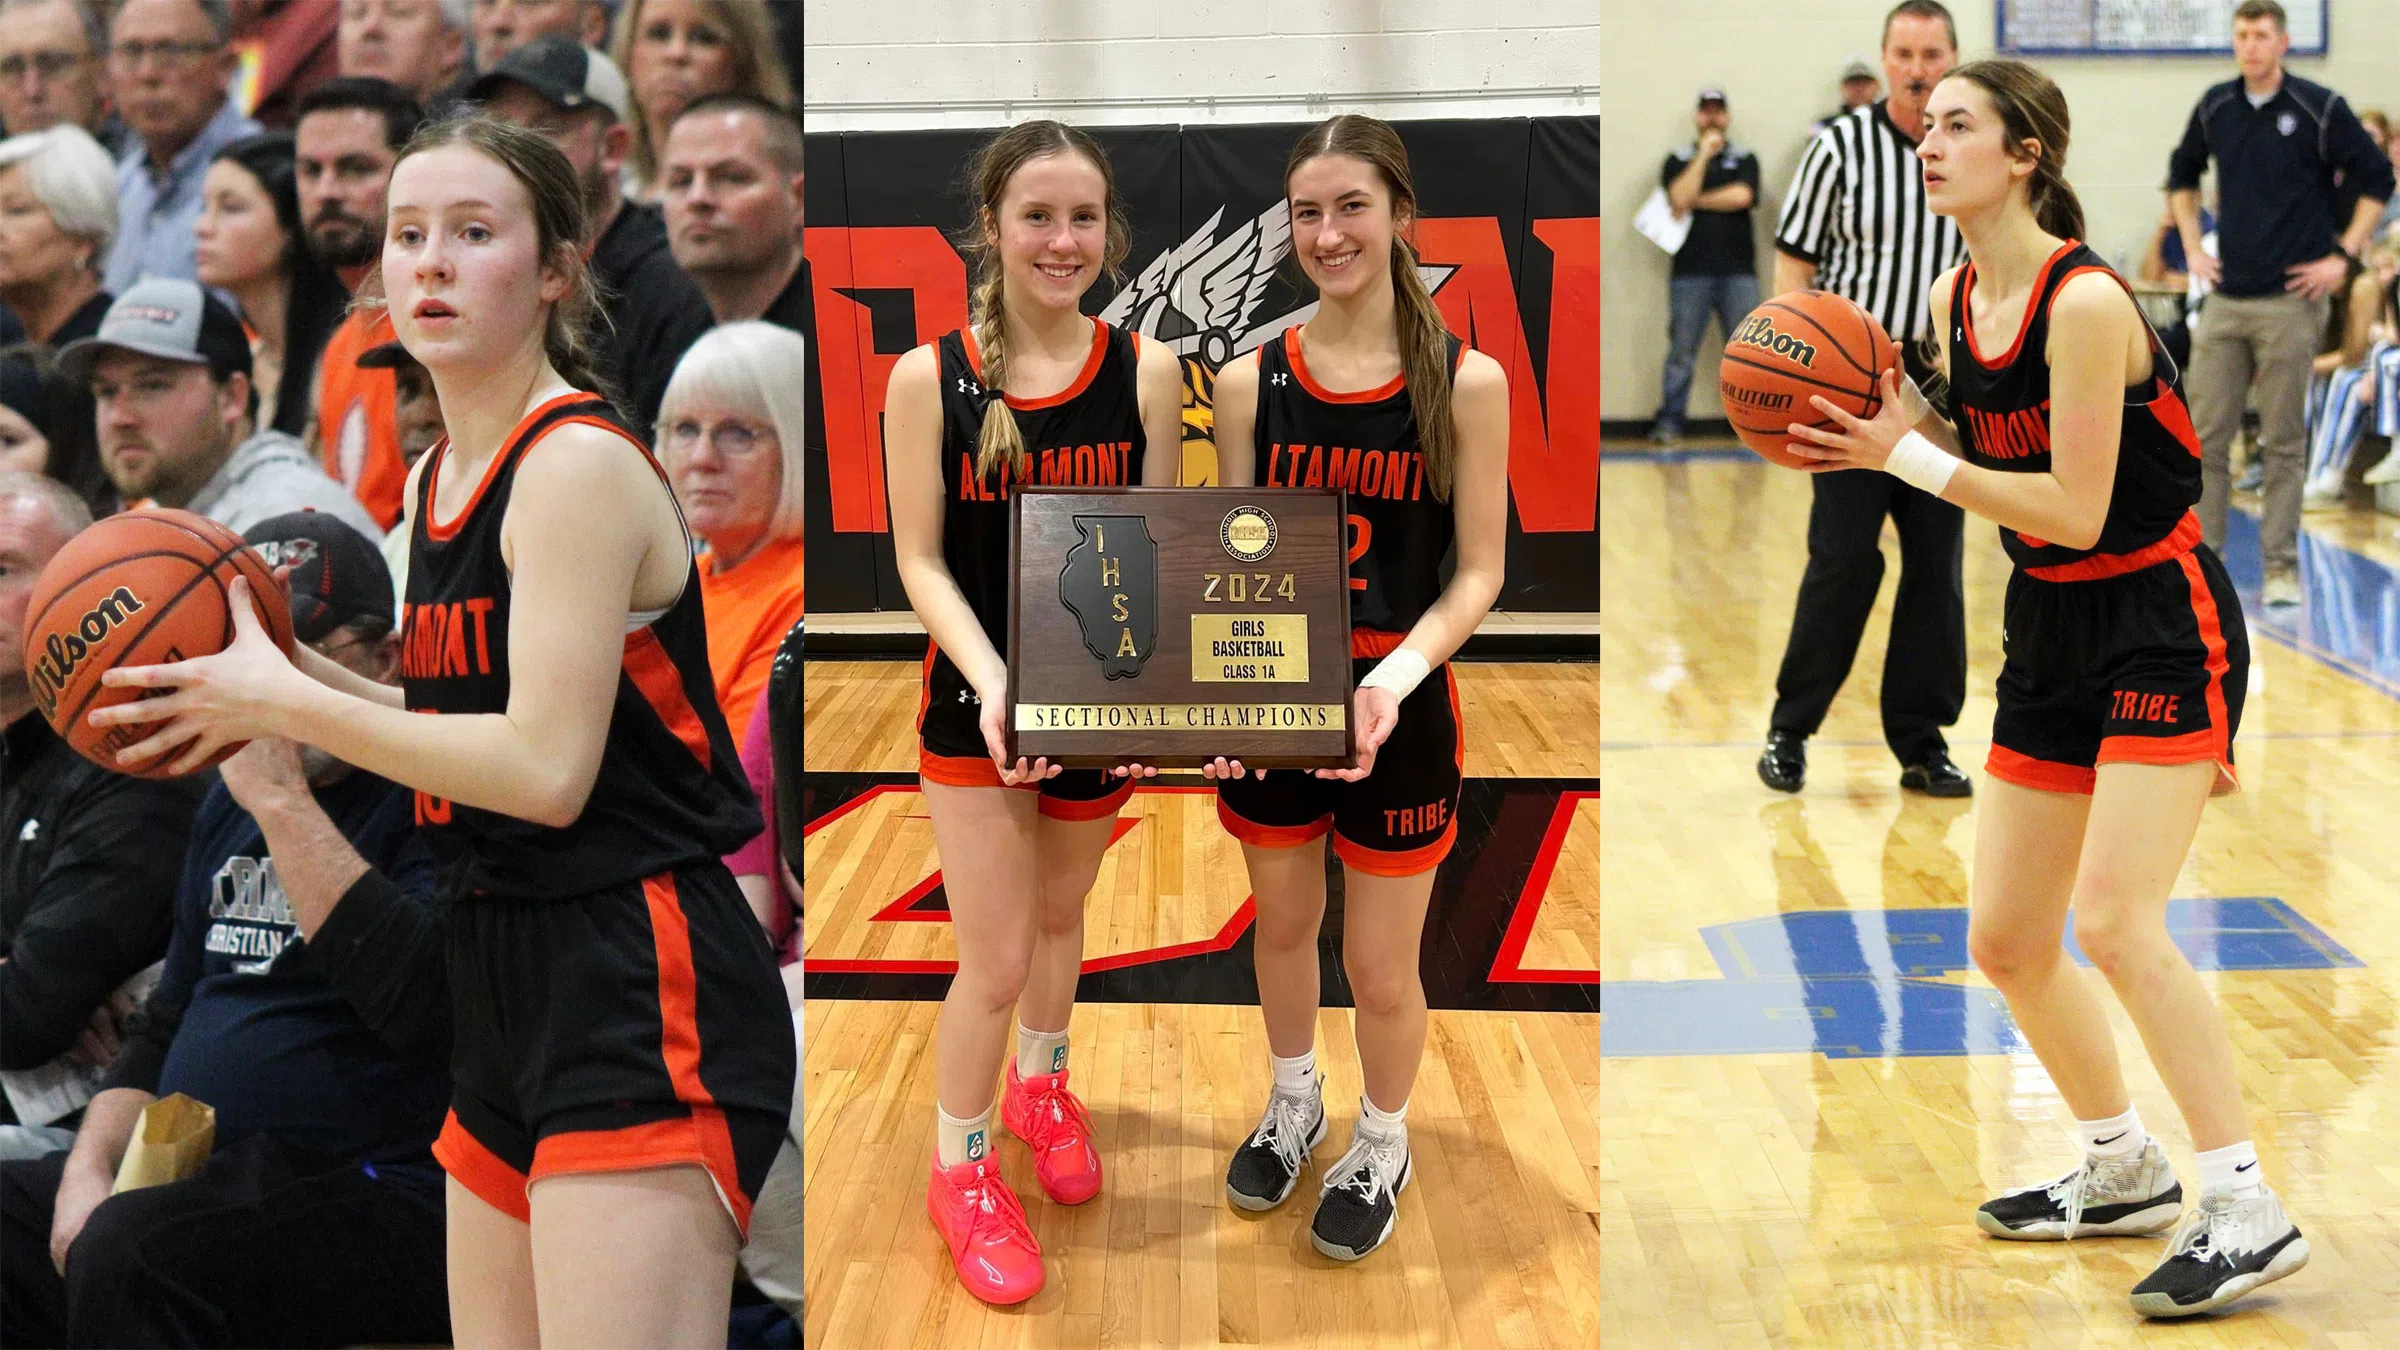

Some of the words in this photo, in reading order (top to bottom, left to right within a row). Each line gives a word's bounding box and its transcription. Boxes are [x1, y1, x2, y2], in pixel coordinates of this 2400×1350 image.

[1239, 507, 1258, 515] HIGH
[1261, 512, 1276, 540] SCHOOL
[1226, 544, 1272, 560] ASSOCIATION
[1204, 573, 1296, 602] 2024
[1232, 620, 1265, 637] GIRLS
[1212, 640, 1285, 657] BASKETBALL
[1223, 664, 1256, 679] CLASS
[1262, 664, 1275, 679] 1A
[1035, 707, 1170, 726] SECTIONAL
[1187, 706, 1327, 726] CHAMPIONS
[2111, 690, 2180, 723] TRIBE
[1383, 798, 1447, 836] TRIBE
